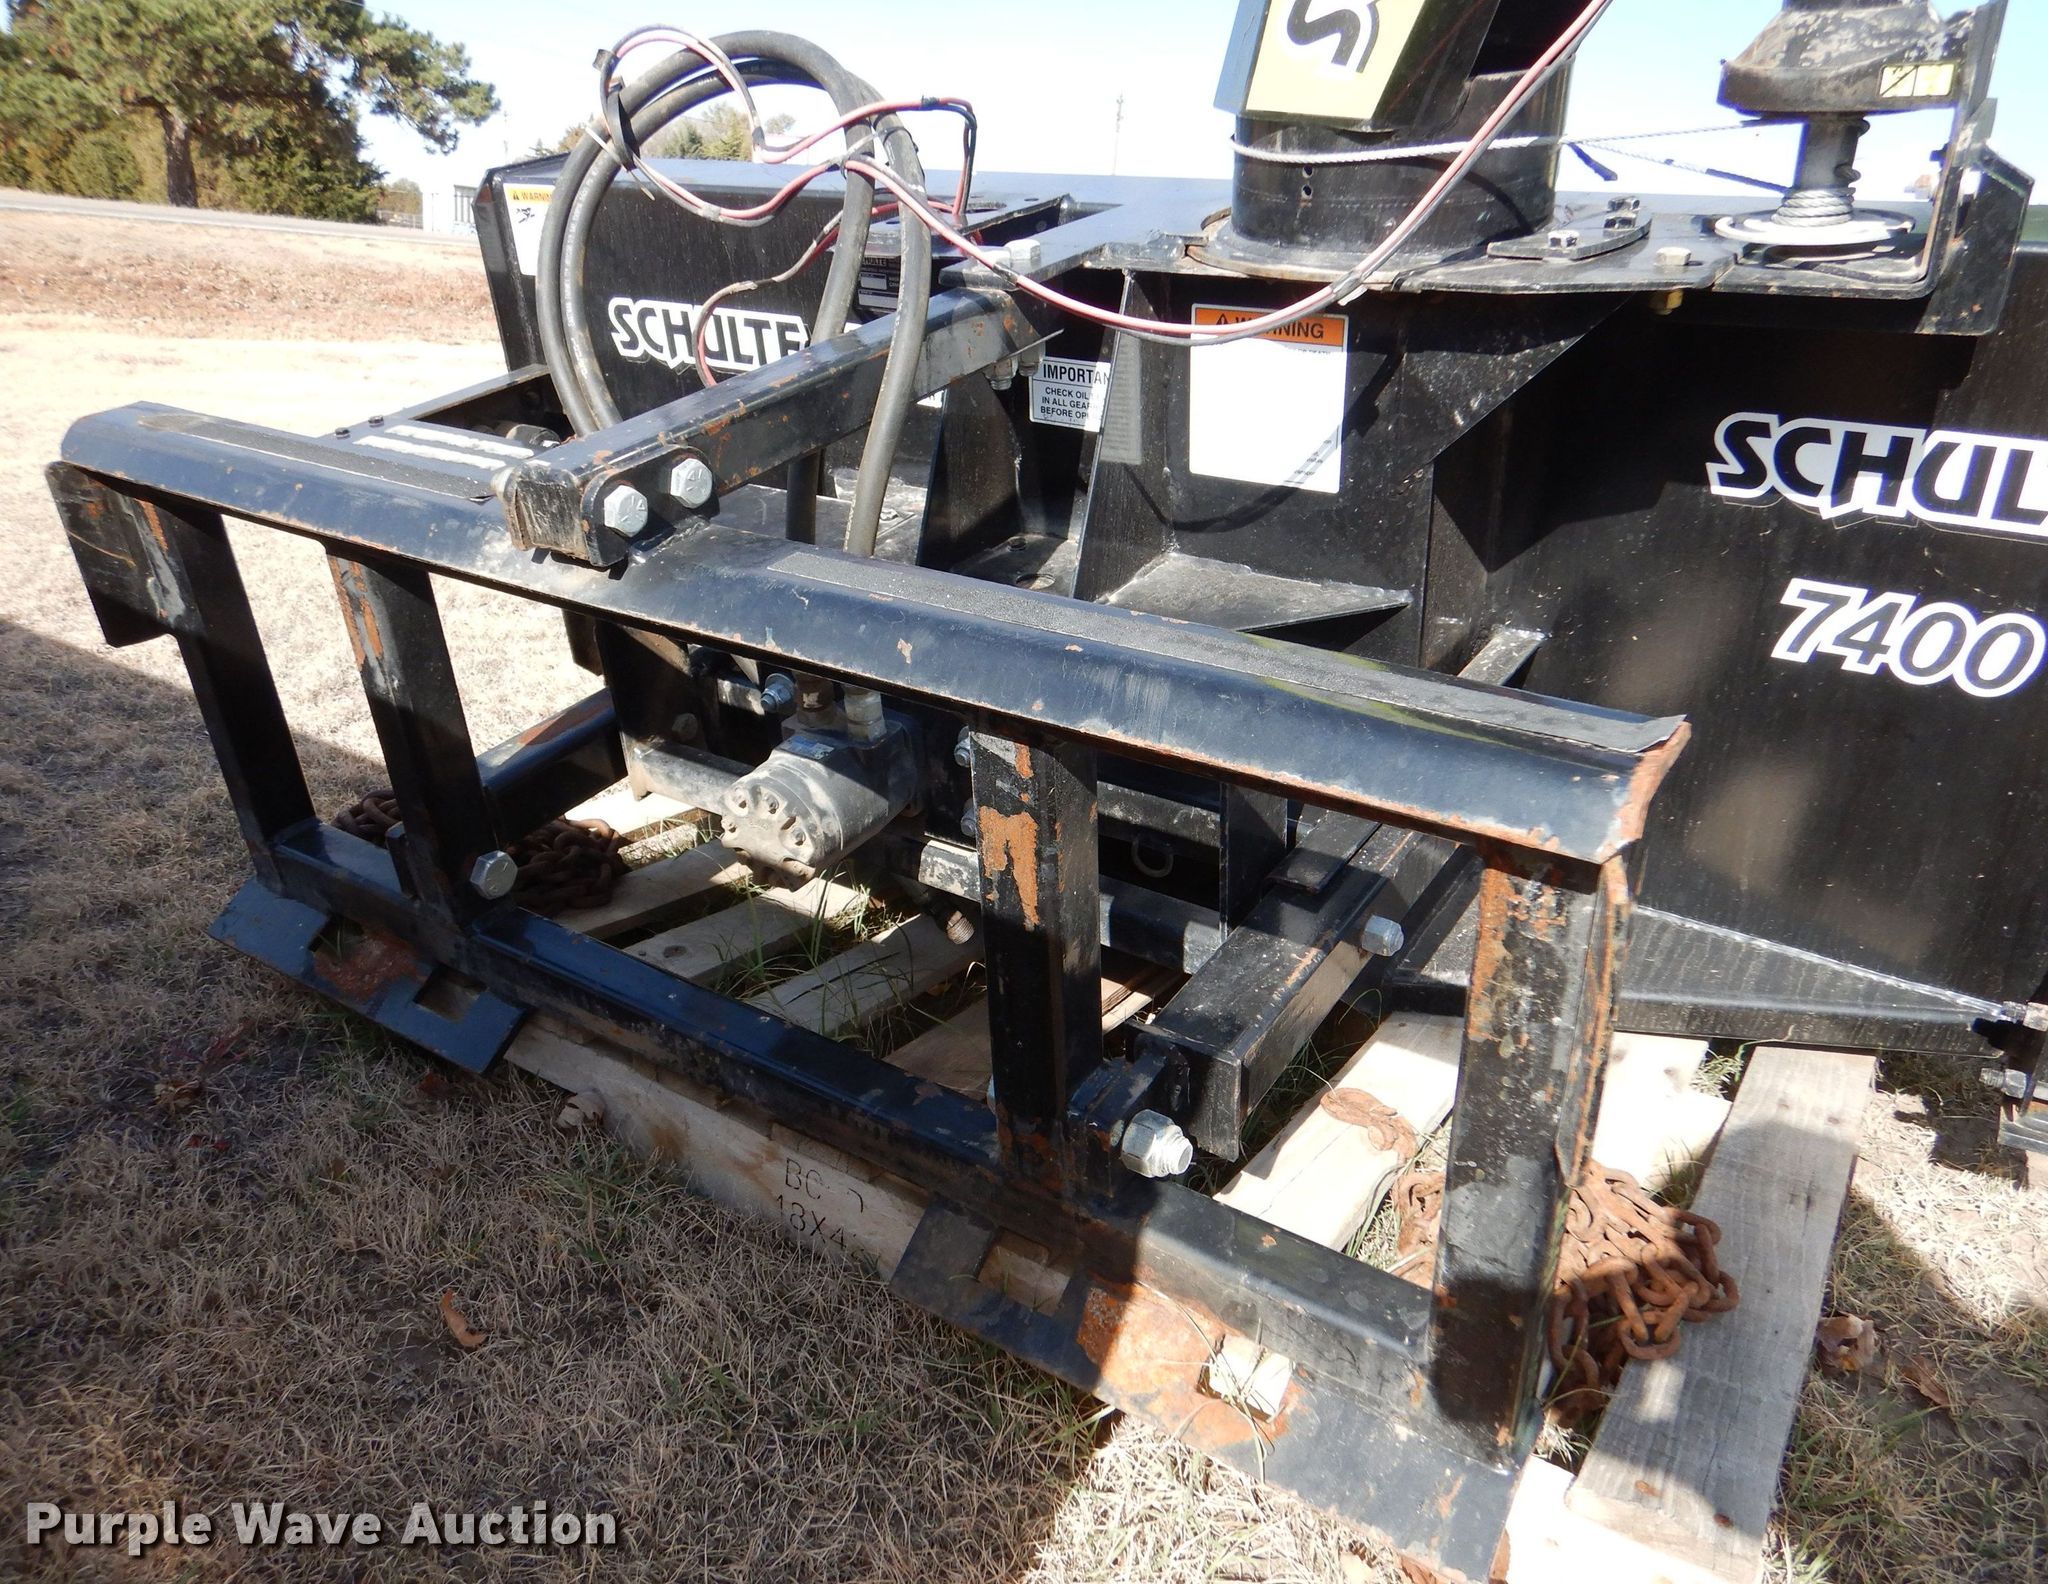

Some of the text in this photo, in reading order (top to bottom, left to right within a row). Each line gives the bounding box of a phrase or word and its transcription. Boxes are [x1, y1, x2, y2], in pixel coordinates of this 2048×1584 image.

[1043, 363, 1109, 385] IMPORTAN
[1045, 386, 1074, 398] CHECK
[1041, 396, 1050, 404] IN
[1052, 397, 1067, 407] ALL
[1040, 405, 1073, 417] BEFORE
[1712, 415, 2048, 528] SCHUL
[1780, 584, 2040, 692] 7400
